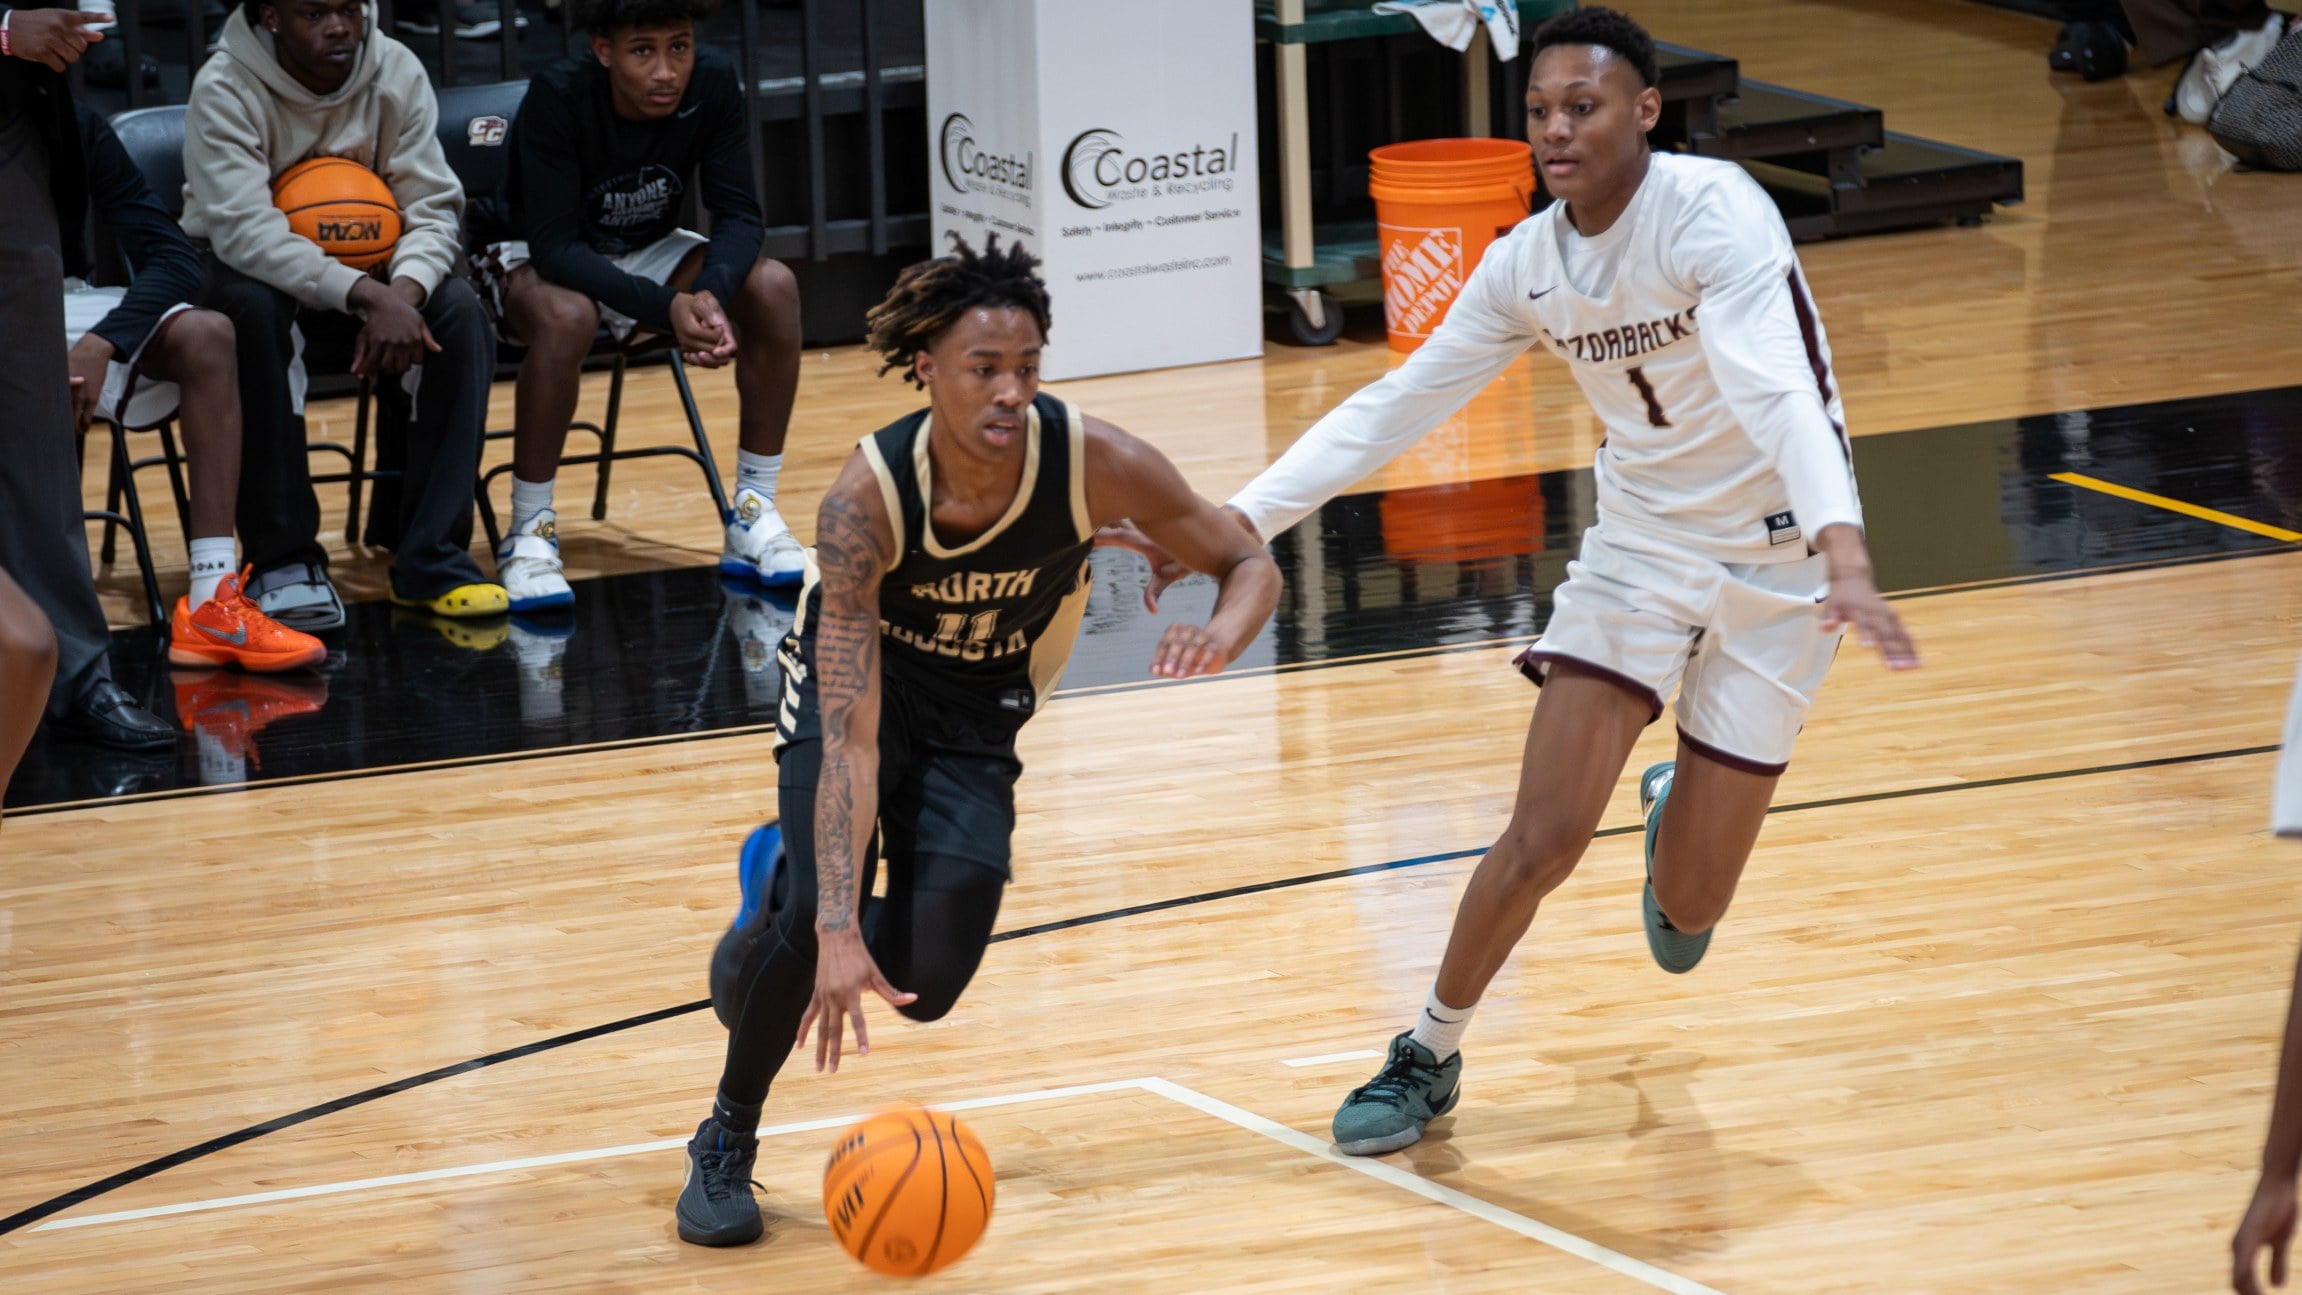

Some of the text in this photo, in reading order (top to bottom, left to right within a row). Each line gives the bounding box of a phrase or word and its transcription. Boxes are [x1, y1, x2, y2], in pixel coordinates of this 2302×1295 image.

[957, 136, 1033, 190] Coastal
[1094, 131, 1239, 187] Coastal
[602, 177, 668, 209] ANYONE
[1152, 184, 1163, 197] &
[1167, 176, 1234, 196] Recycling
[317, 221, 382, 241] NCAA
[1103, 218, 1144, 232] Integrity
[1154, 211, 1202, 227] Customer
[1204, 207, 1242, 221] Service
[1385, 229, 1462, 331] HOME
[1403, 268, 1462, 335] DEPOT
[1625, 366, 1674, 428] 1
[1775, 514, 1790, 527] M
[934, 608, 1004, 642] 11
